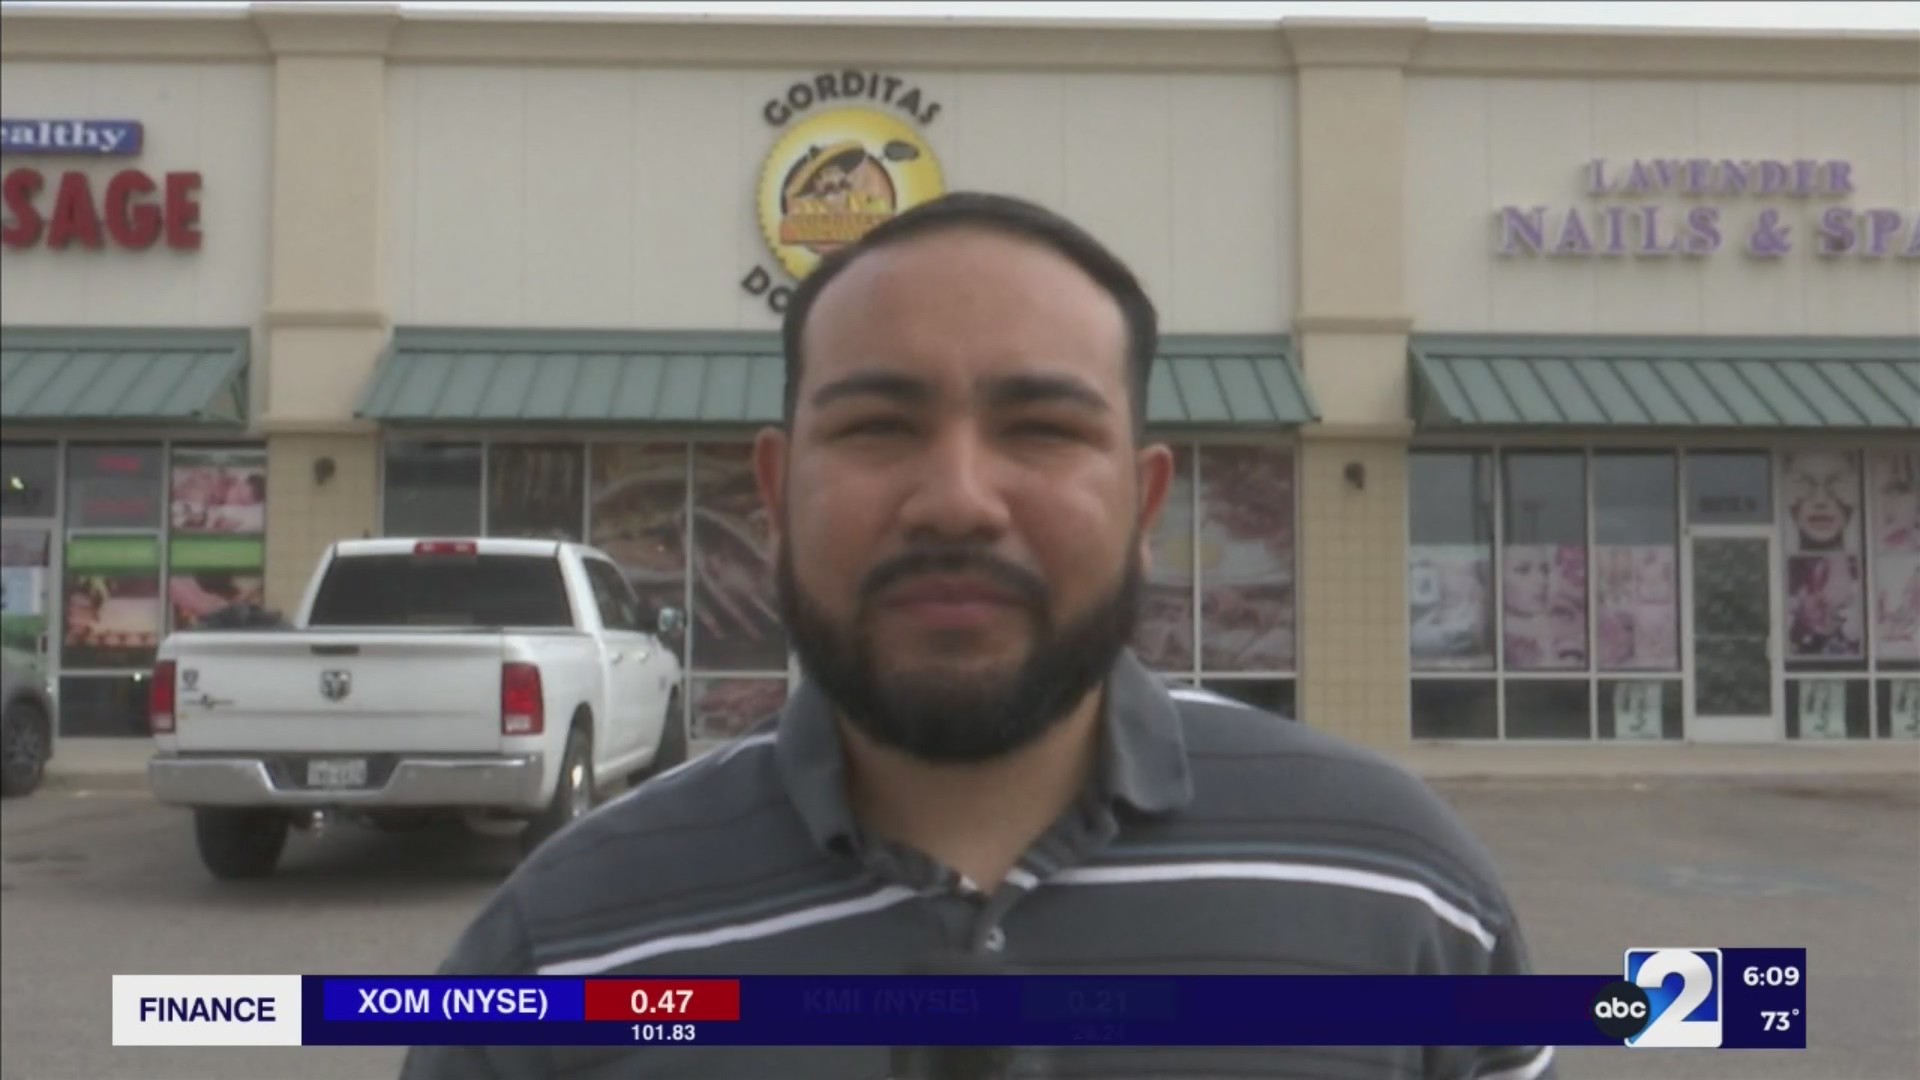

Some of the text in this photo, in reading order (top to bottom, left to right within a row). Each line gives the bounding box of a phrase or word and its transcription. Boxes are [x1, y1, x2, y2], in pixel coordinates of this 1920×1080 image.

[763, 70, 941, 127] GORDITAS
[1590, 158, 1855, 195] LAVENDER
[1500, 205, 1722, 254] NAILS
[1749, 207, 1791, 255] &
